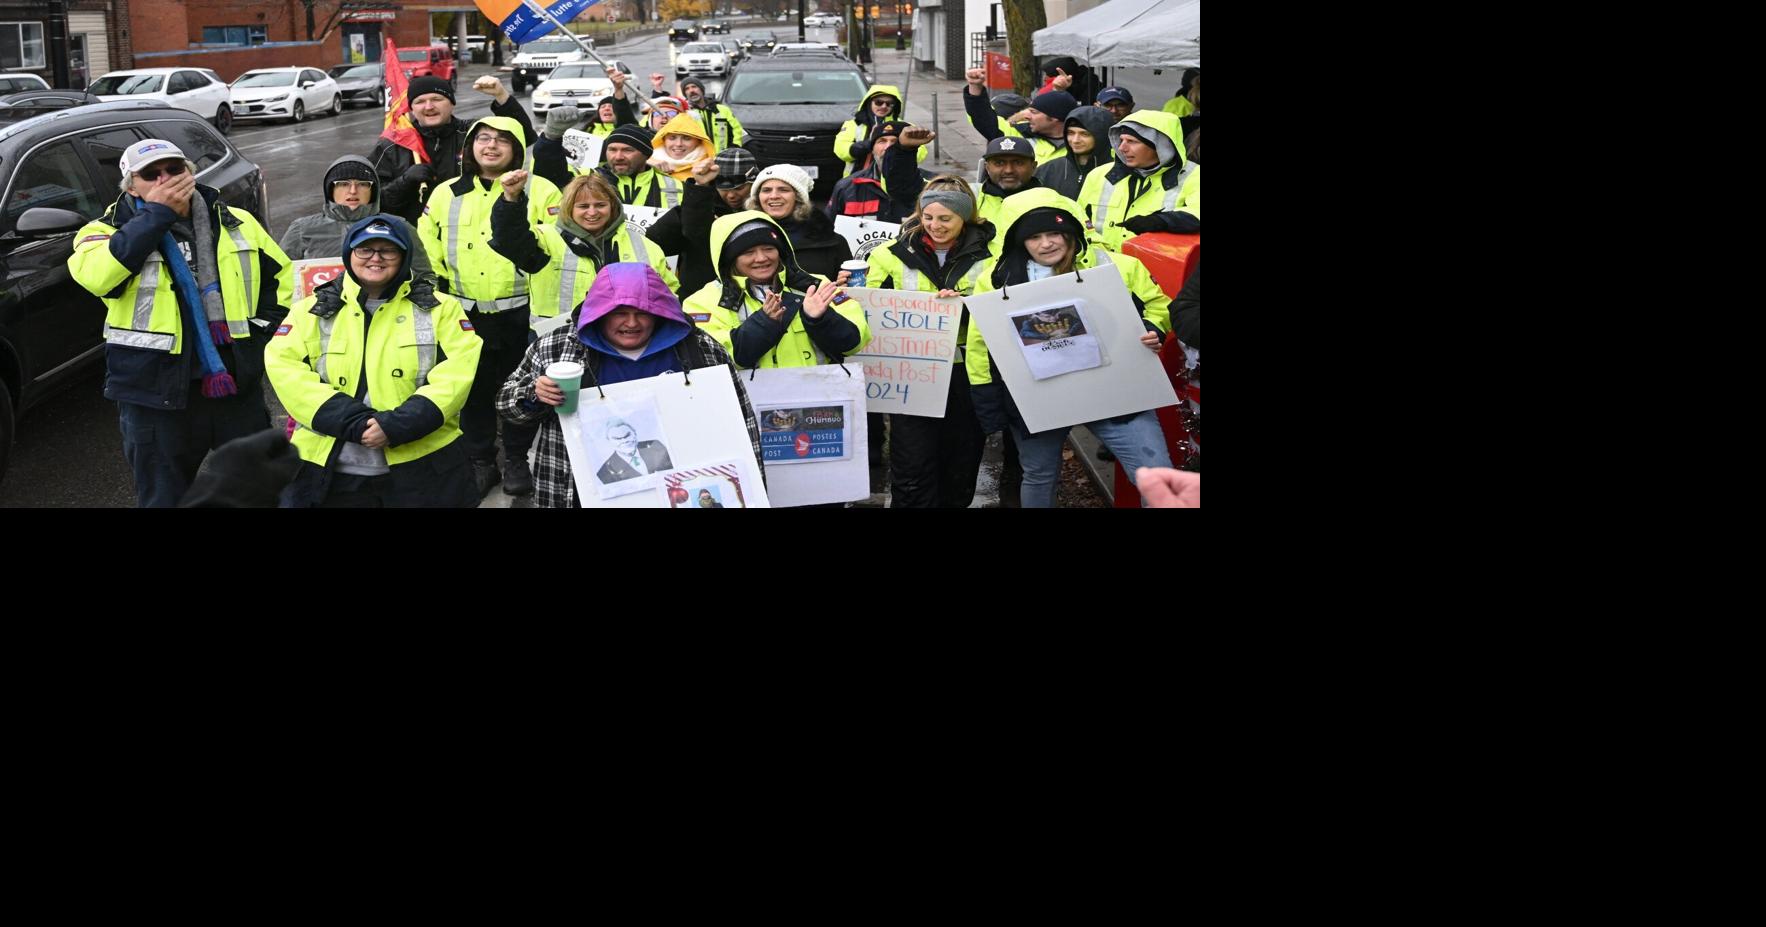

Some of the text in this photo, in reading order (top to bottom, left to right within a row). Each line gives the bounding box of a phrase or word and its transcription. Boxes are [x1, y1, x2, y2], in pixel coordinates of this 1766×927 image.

[550, 0, 573, 17] lutte
[563, 134, 579, 142] OCAL
[856, 231, 893, 245] LOCAL
[869, 290, 958, 319] Corporation
[881, 310, 951, 332] STOLE
[863, 336, 952, 358] RISTMAS
[863, 361, 943, 384] ada Post
[866, 382, 909, 404] 024
[763, 432, 837, 443] CANADA POSTES
[812, 447, 840, 455] CANADA
